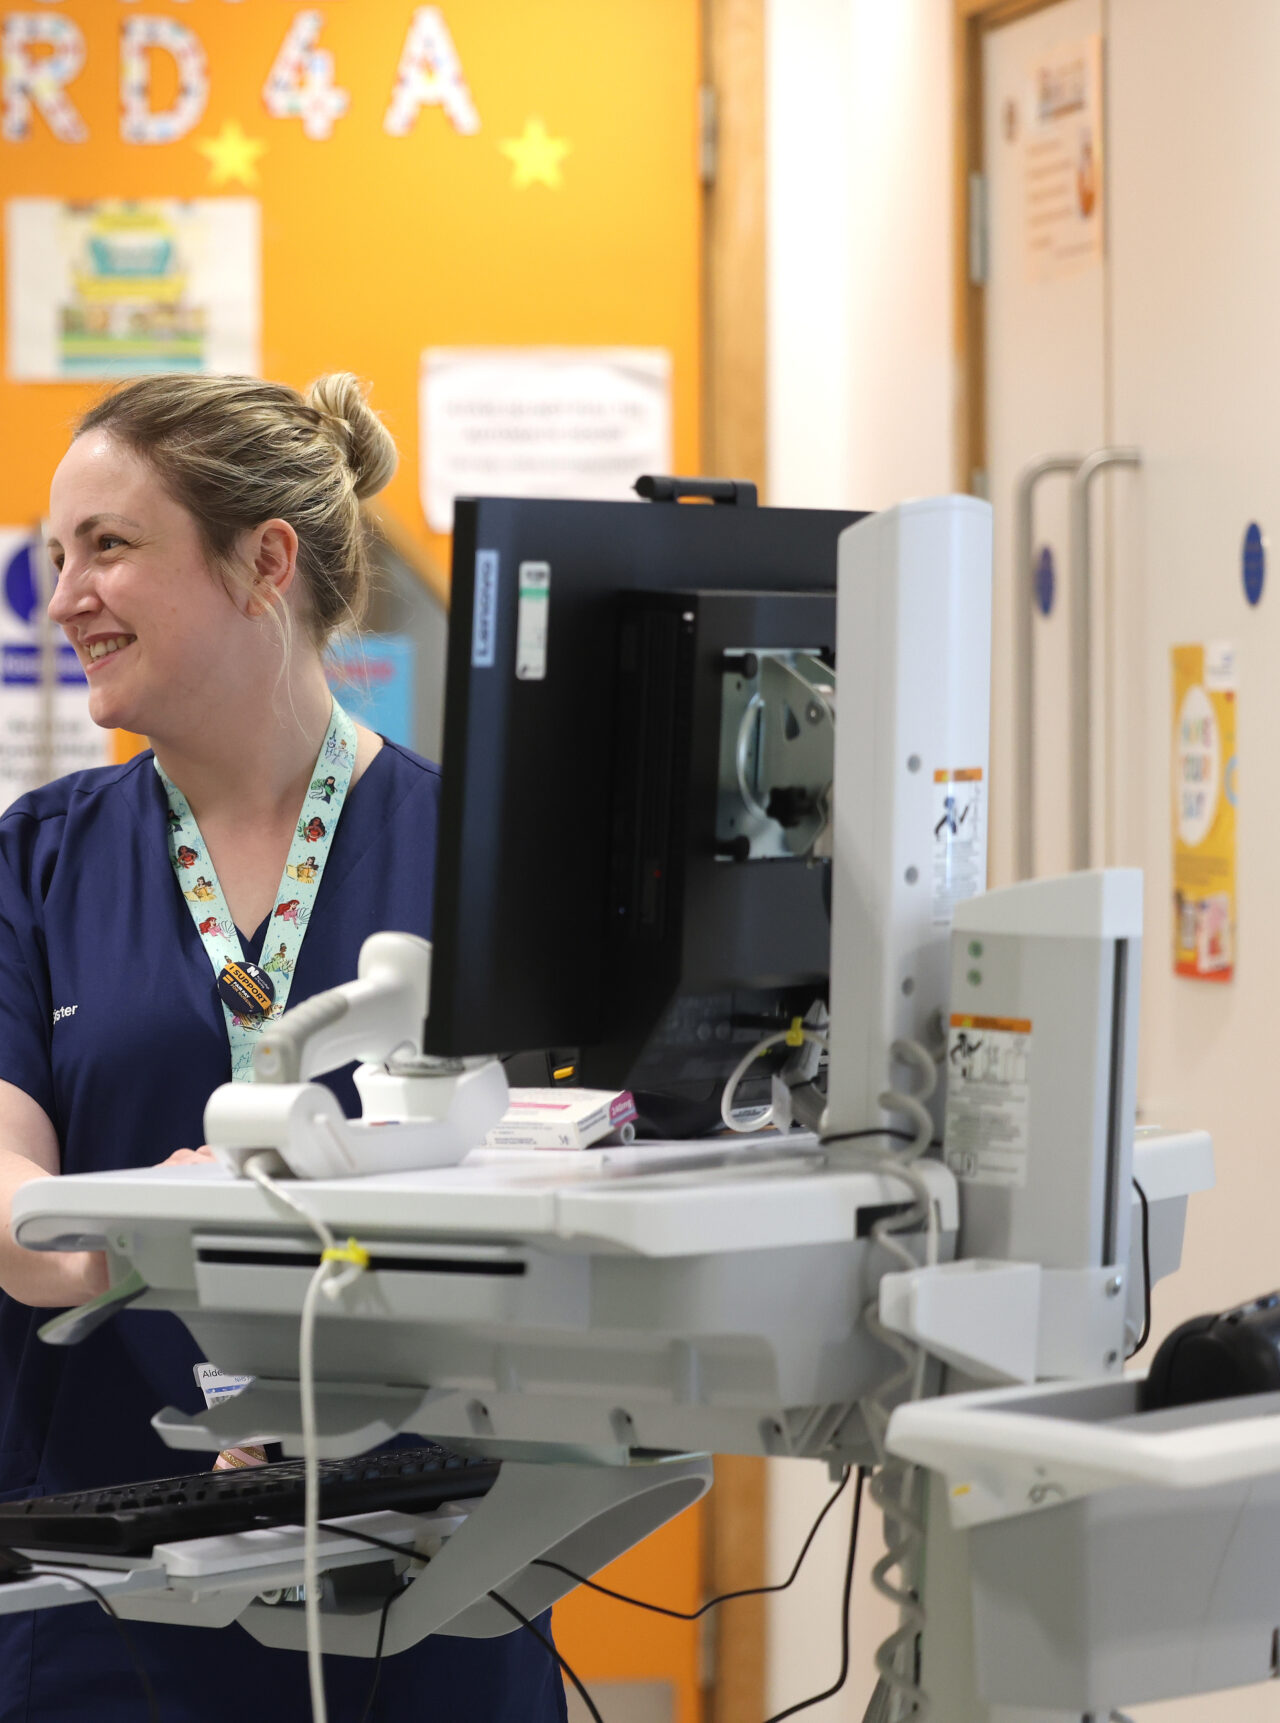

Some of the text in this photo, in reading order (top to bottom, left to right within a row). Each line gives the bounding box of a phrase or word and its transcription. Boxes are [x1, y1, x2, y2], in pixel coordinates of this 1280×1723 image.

[477, 561, 491, 658] Lenovo
[232, 969, 268, 1004] SUPPORT
[53, 1005, 78, 1025] ister
[202, 1369, 225, 1378] Alde
